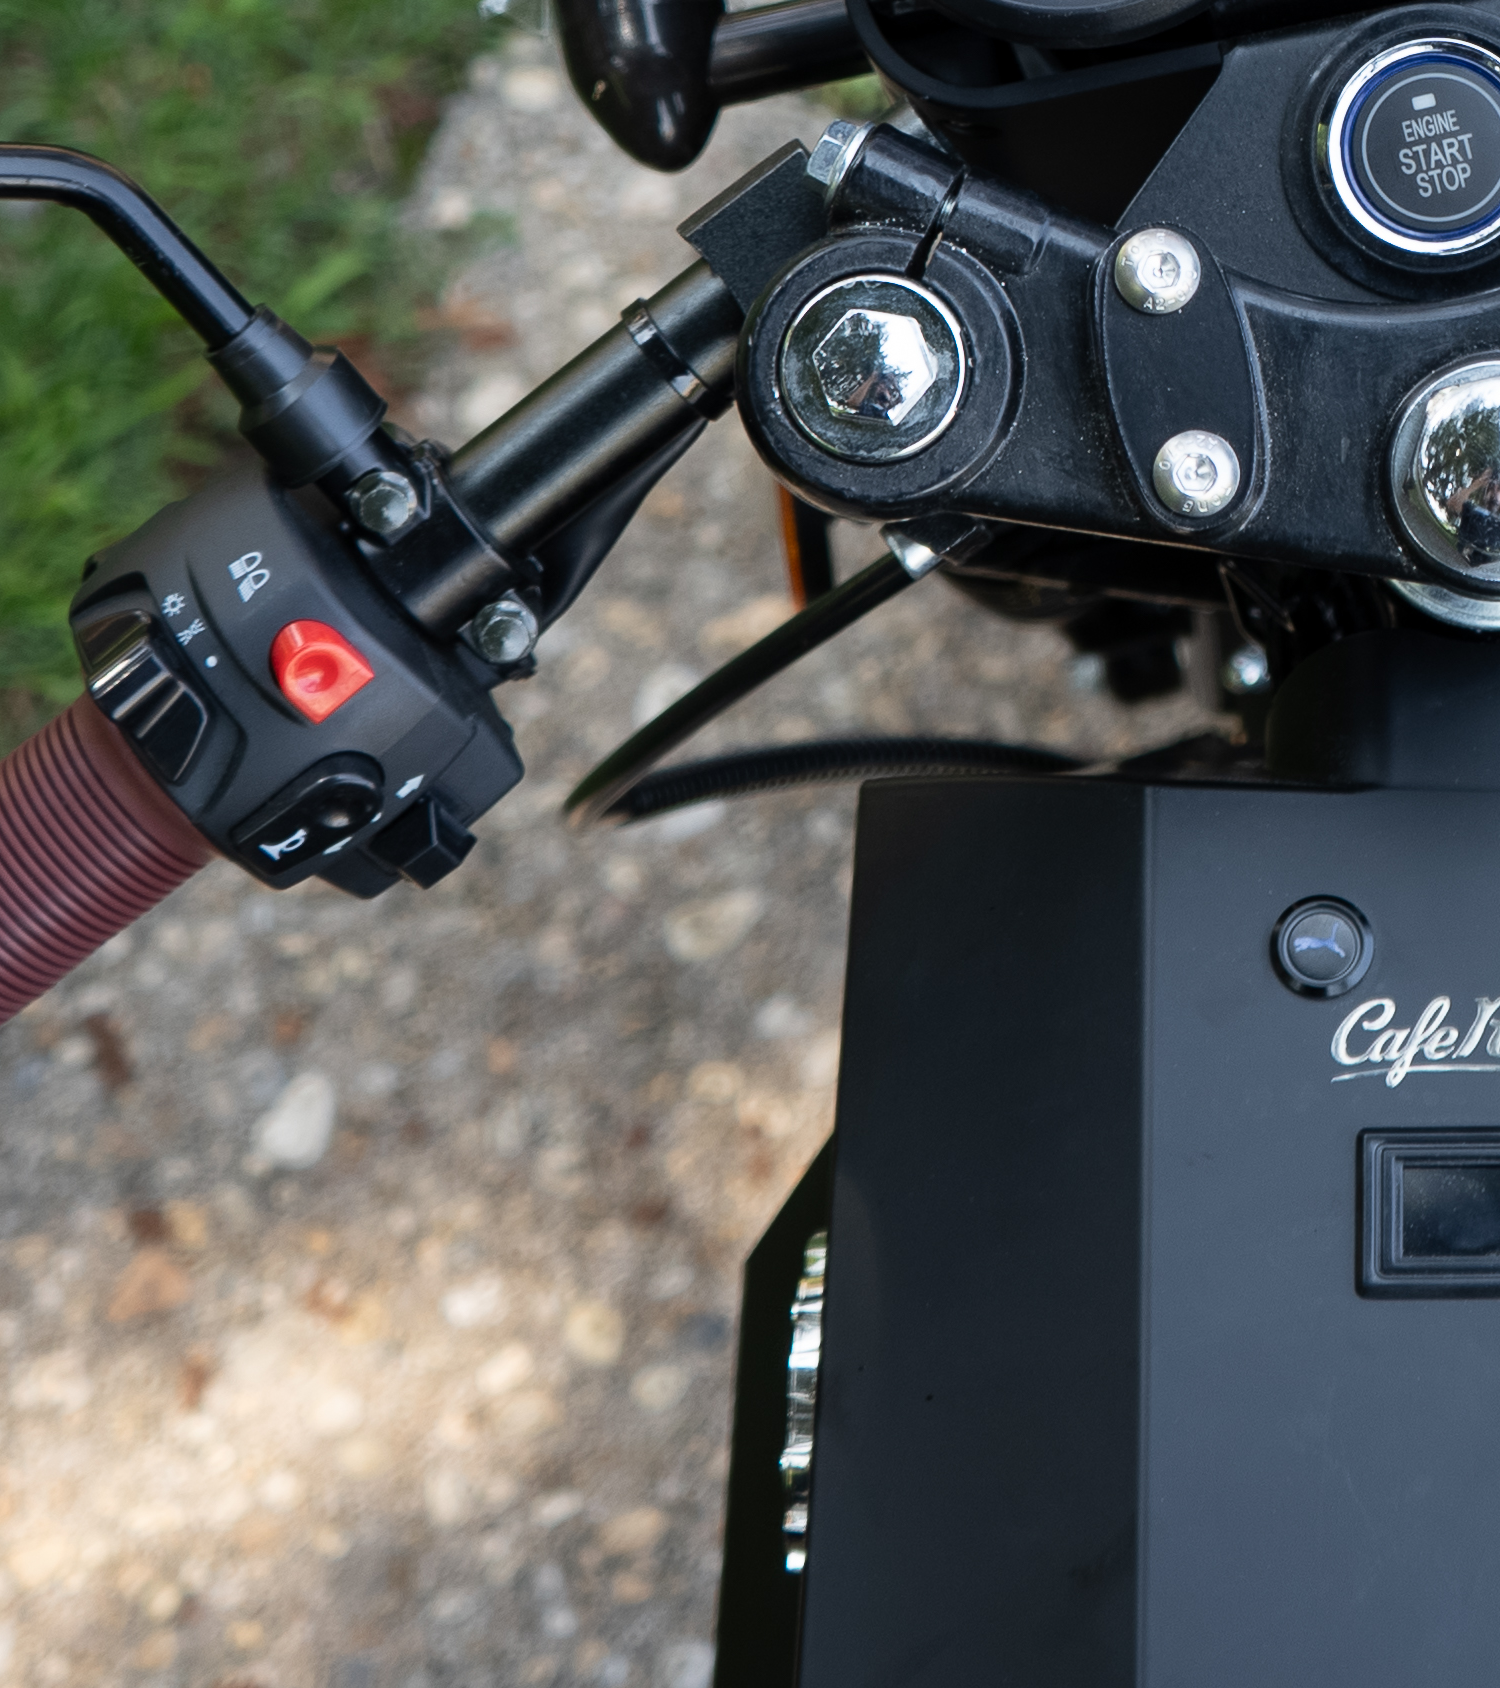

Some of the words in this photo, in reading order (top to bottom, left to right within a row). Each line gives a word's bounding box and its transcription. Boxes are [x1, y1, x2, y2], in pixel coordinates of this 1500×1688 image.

[1402, 109, 1460, 143] ENGINE
[1399, 133, 1473, 175] START
[1416, 162, 1472, 198] STOP
[1330, 996, 1459, 1088] Cafe
